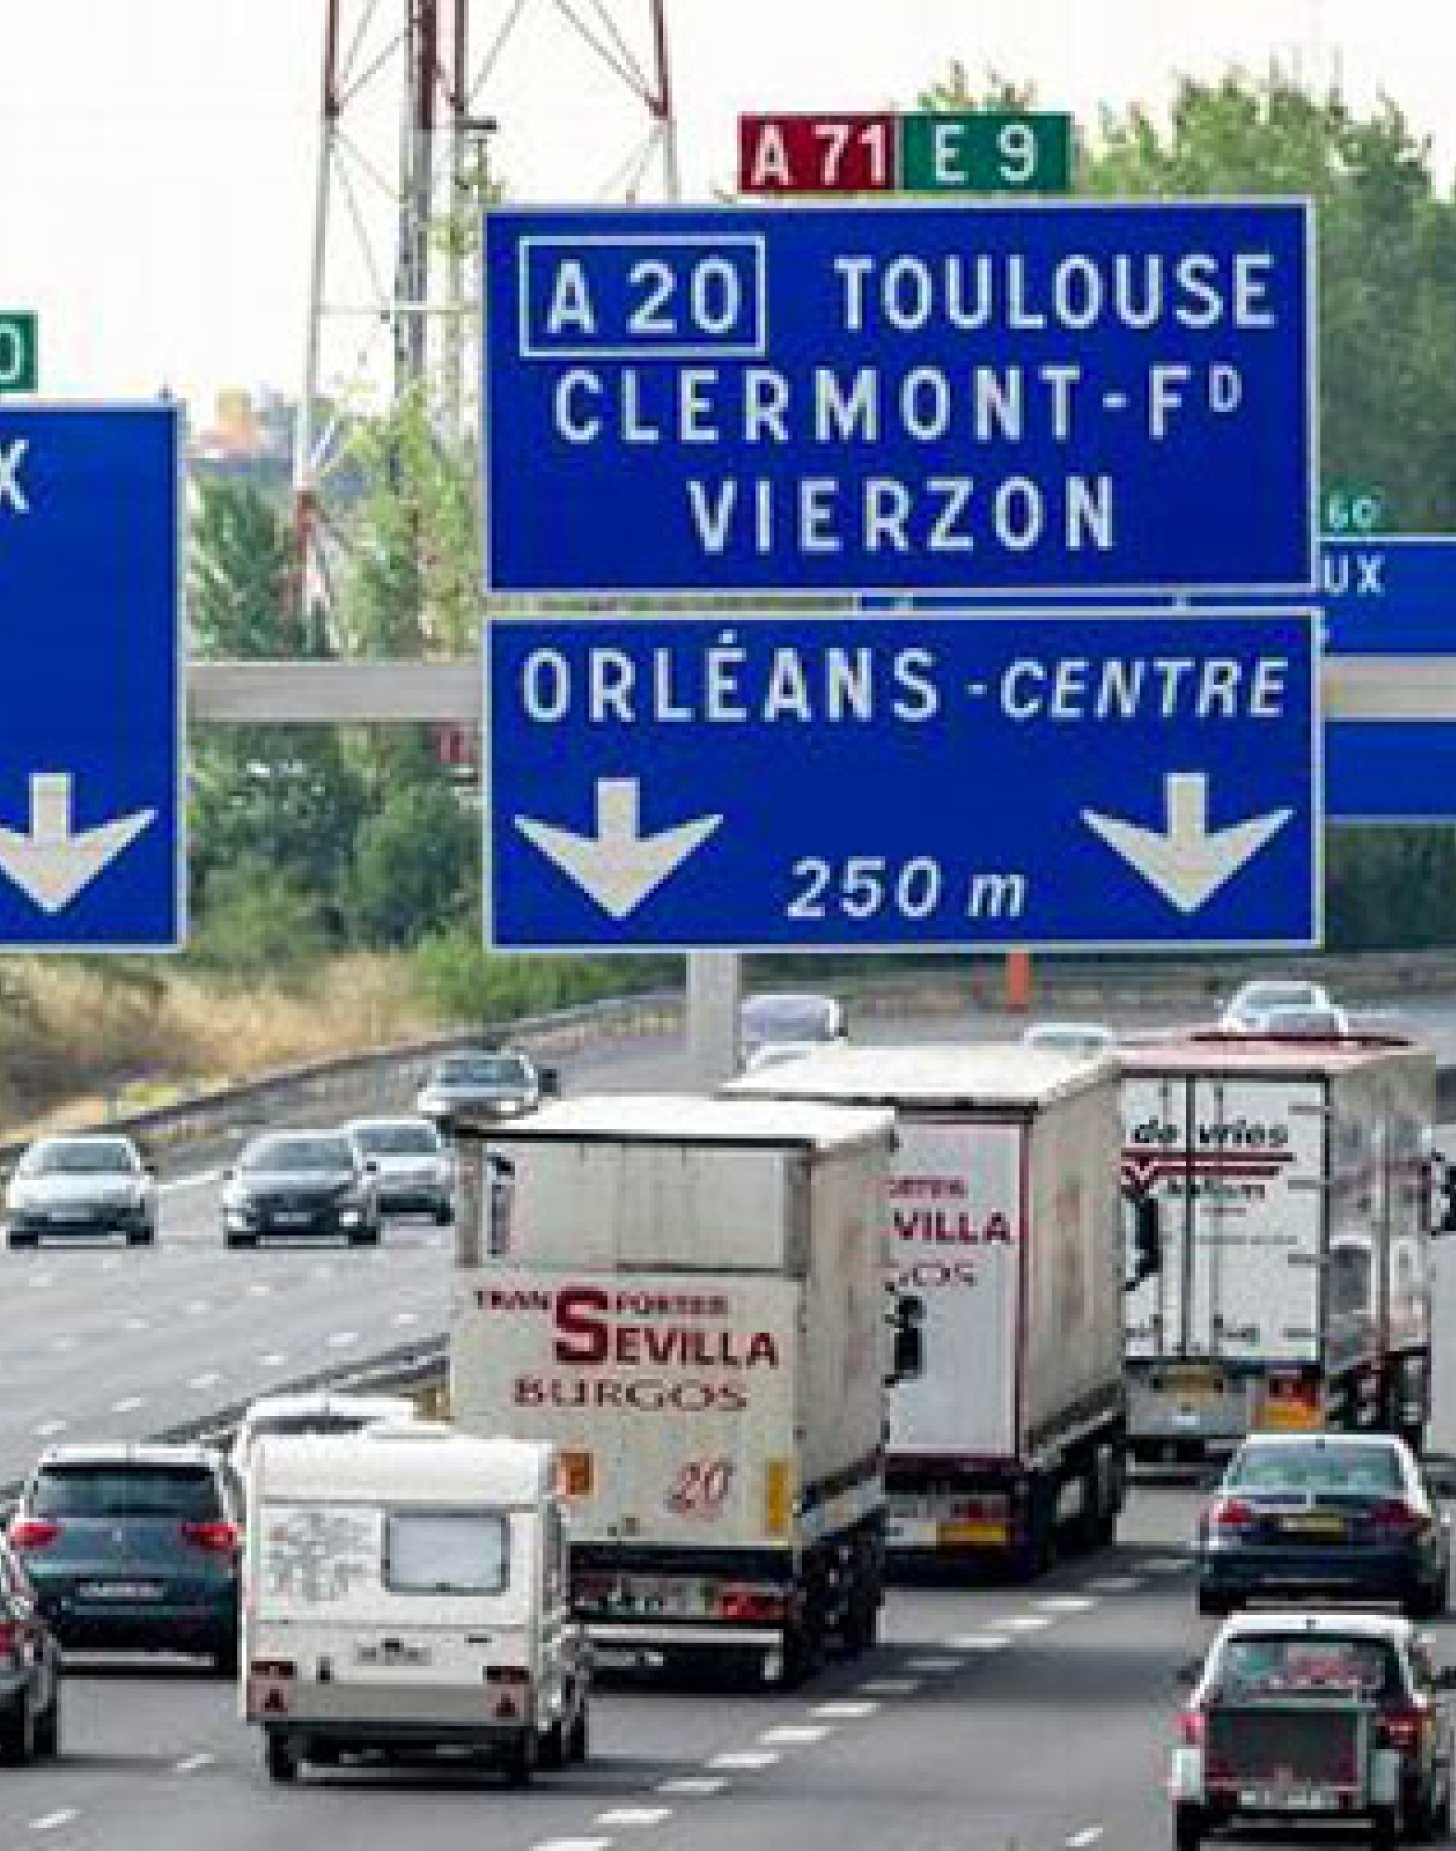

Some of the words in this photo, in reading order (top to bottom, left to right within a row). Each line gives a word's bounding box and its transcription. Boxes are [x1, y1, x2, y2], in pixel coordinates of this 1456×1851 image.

[750, 127, 792, 188] A
[814, 124, 888, 185] 71
[934, 125, 967, 183] E
[999, 124, 1036, 183] 9
[546, 260, 595, 334] A
[628, 259, 741, 335] 20
[834, 253, 1275, 331] TOULOUSE
[686, 475, 1115, 552] VIERZON
[785, 857, 942, 920] 250
[967, 868, 1026, 918] m
[893, 1209, 1013, 1244] VILLA
[554, 1286, 780, 1370] SEVILLA
[514, 1378, 749, 1412] BURGOS
